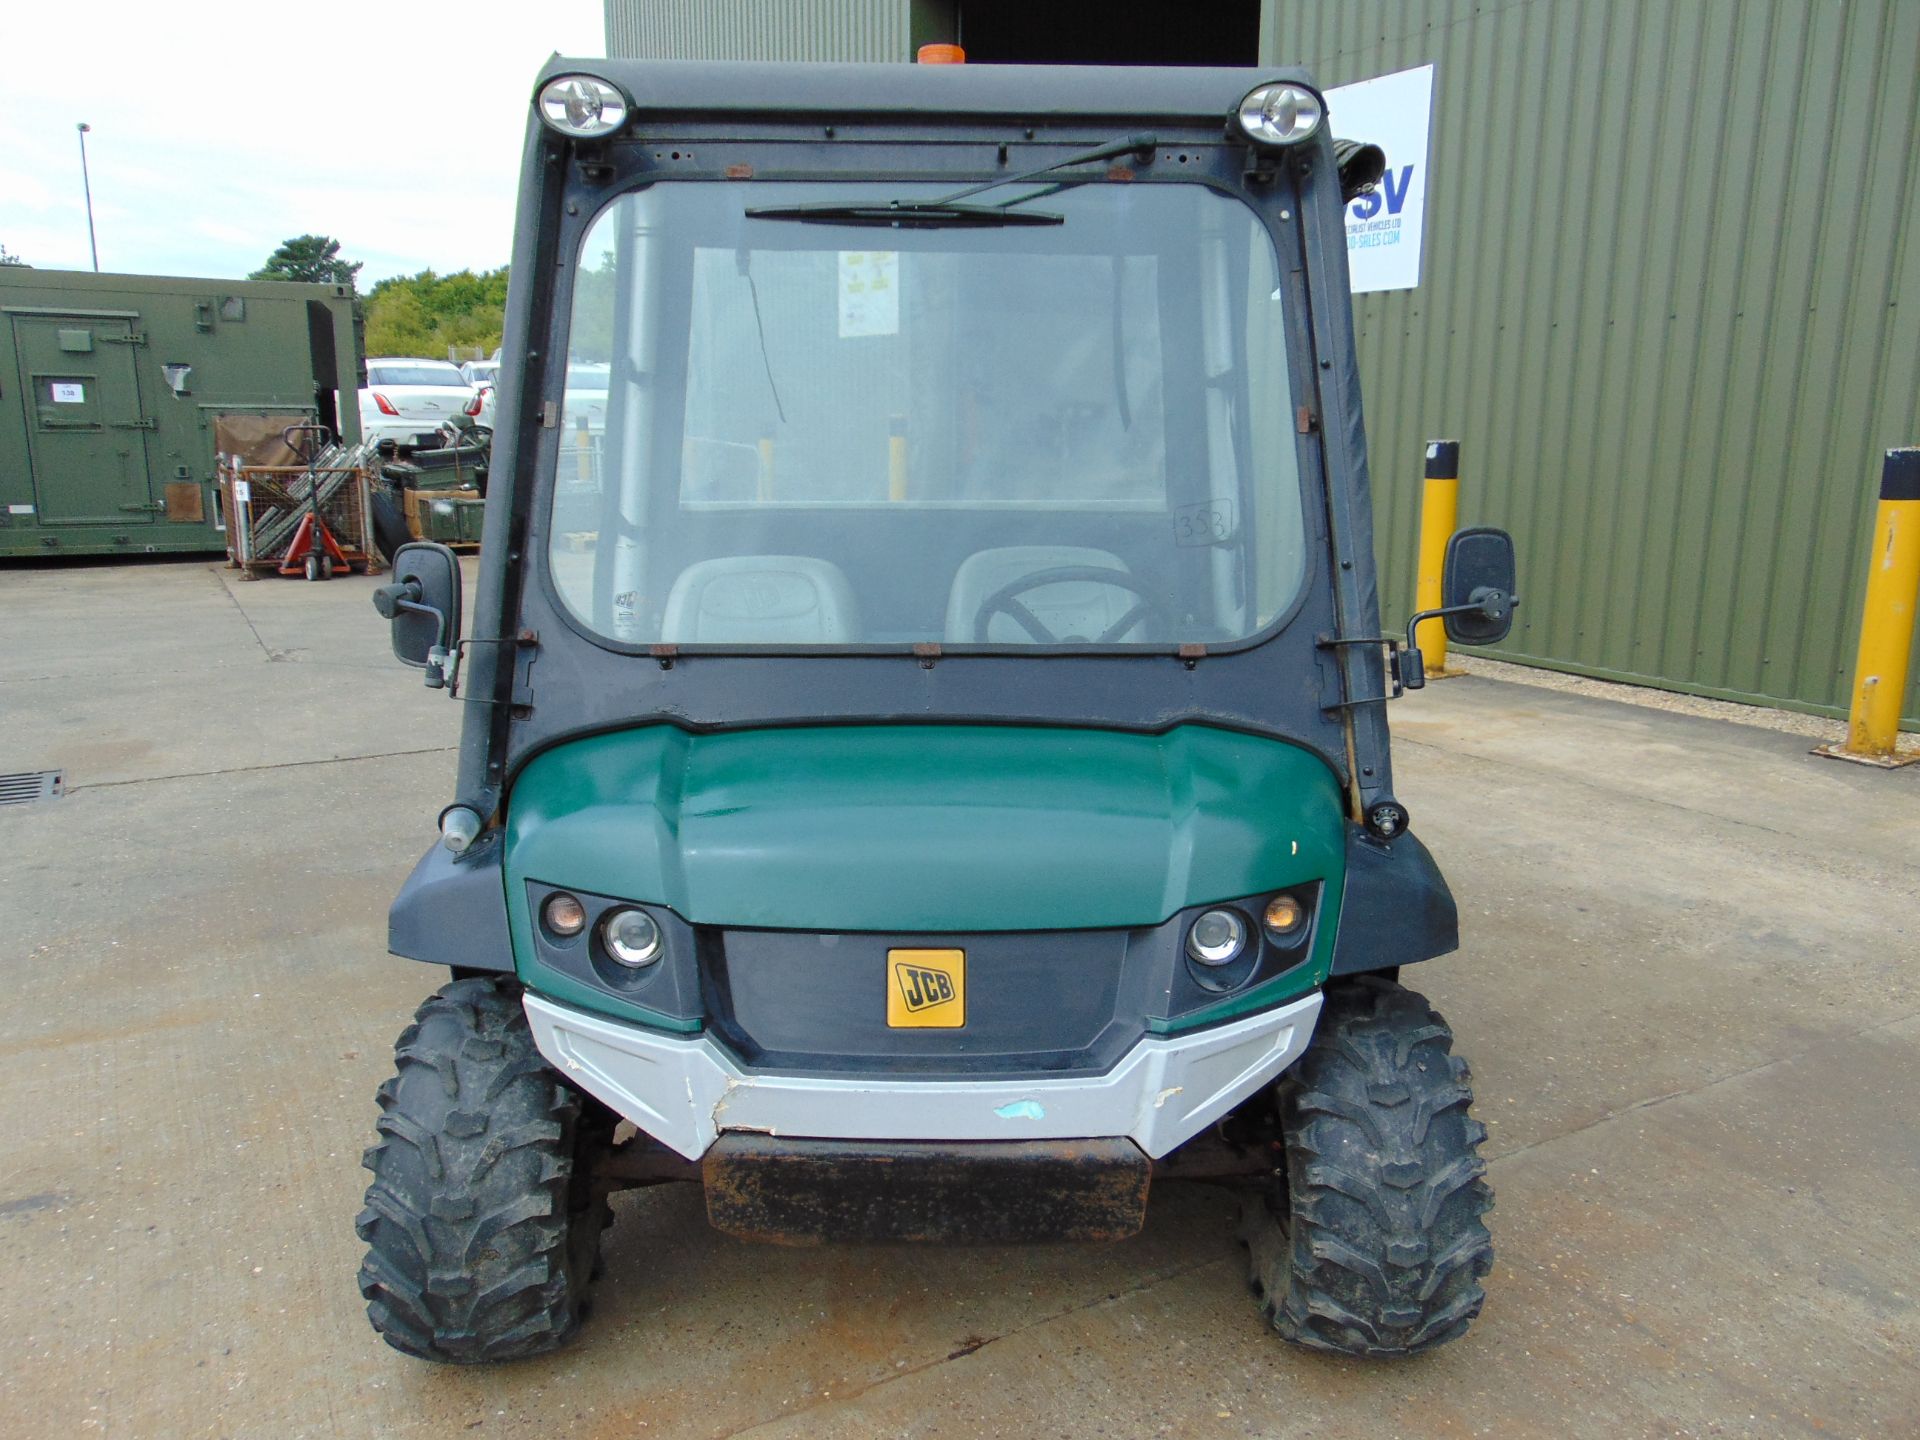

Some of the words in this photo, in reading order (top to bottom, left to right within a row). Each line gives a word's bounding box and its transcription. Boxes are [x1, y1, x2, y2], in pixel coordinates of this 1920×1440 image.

[1344, 165, 1414, 219] SV
[1367, 219, 1391, 231] VEHICLES
[1180, 509, 1225, 537] 353
[906, 969, 952, 1007] JCB
